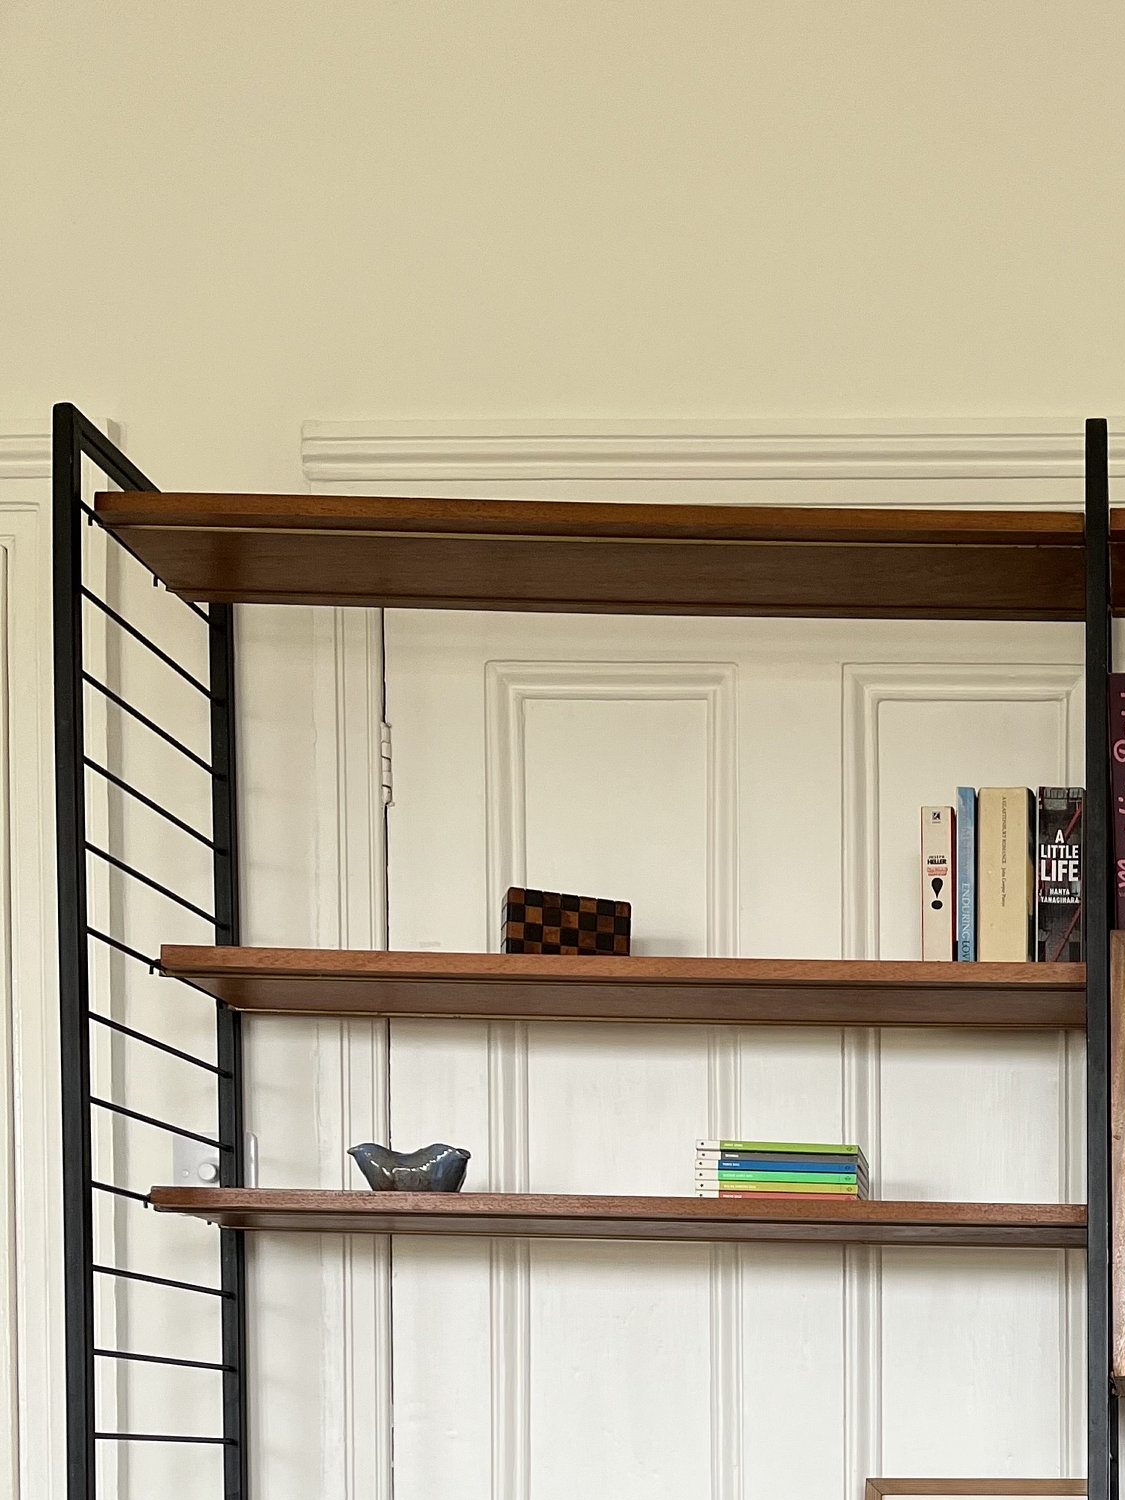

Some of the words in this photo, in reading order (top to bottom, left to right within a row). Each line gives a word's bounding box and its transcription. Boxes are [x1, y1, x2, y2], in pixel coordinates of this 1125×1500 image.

[1054, 829, 1065, 843] A
[1040, 845, 1079, 858] LITTLE
[1040, 860, 1079, 882] LIFE
[1049, 888, 1070, 896] HANYA
[1040, 896, 1080, 904] YANAGIHARA
[961, 883, 971, 940] ENDURING
[961, 940, 971, 961] LOV
